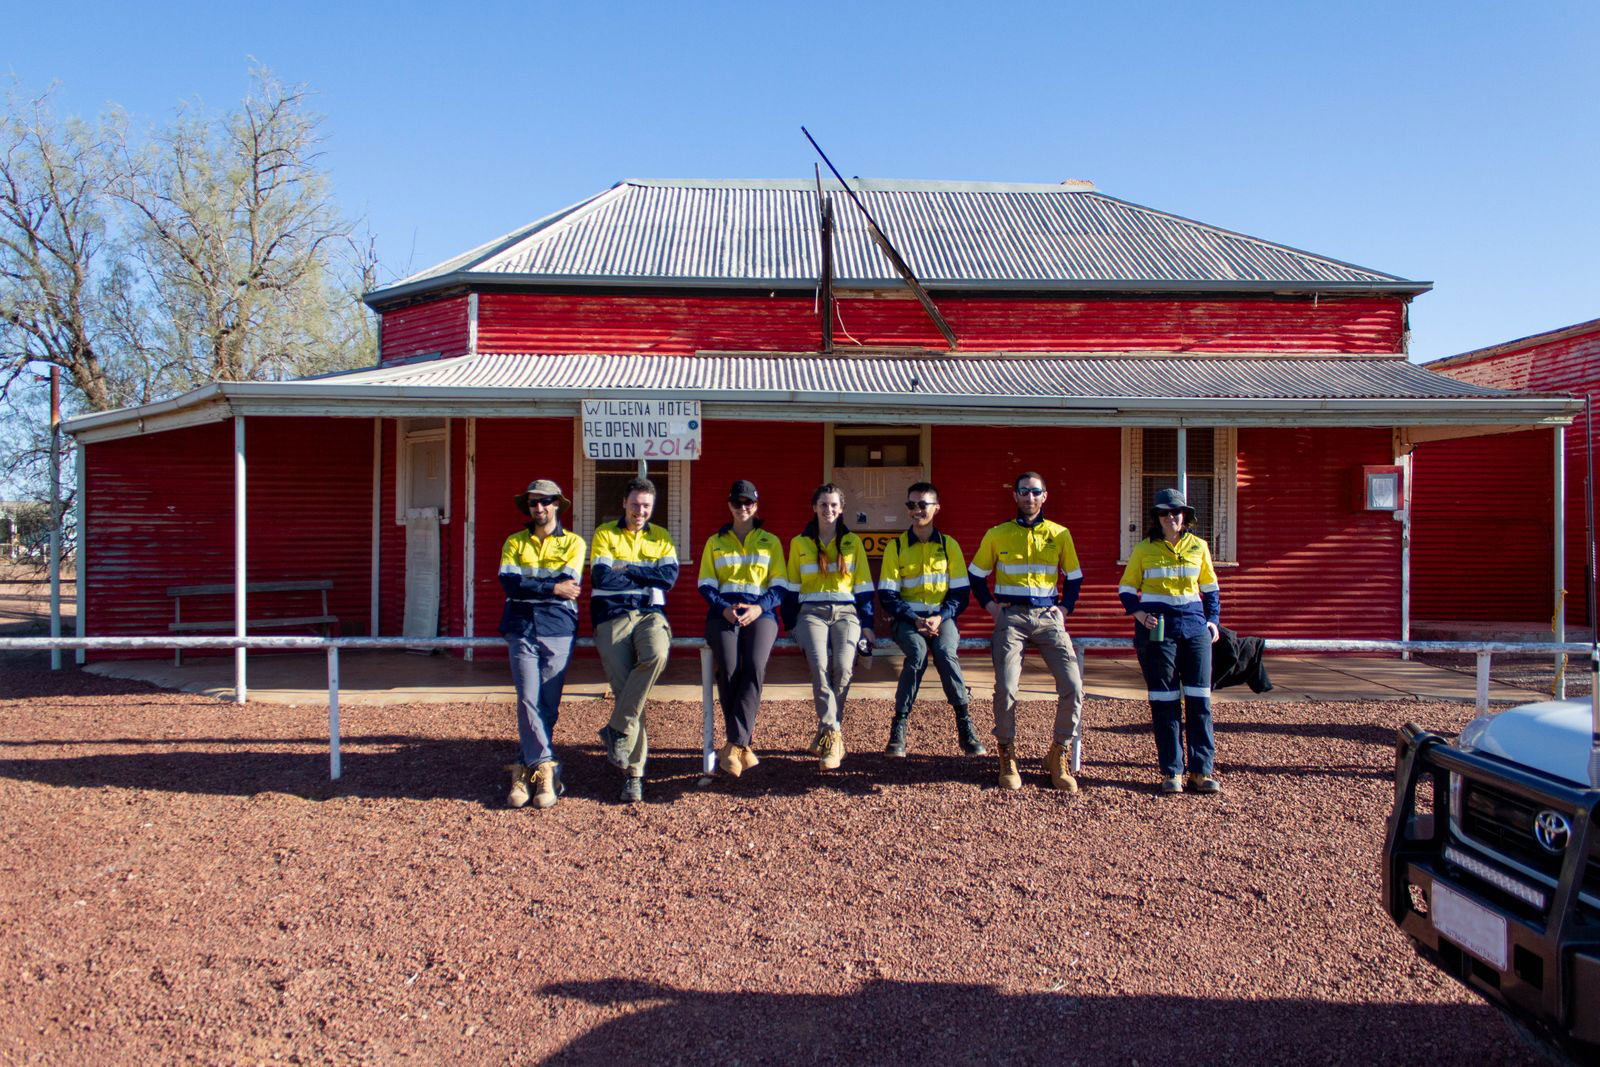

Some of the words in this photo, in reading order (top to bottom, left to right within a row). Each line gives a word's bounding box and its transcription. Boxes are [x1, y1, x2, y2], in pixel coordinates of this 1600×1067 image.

[584, 401, 651, 416] WILGENA
[658, 401, 699, 416] HOTEL
[584, 421, 668, 438] REOPENING
[589, 442, 636, 458] SOON
[643, 438, 697, 457] 2014
